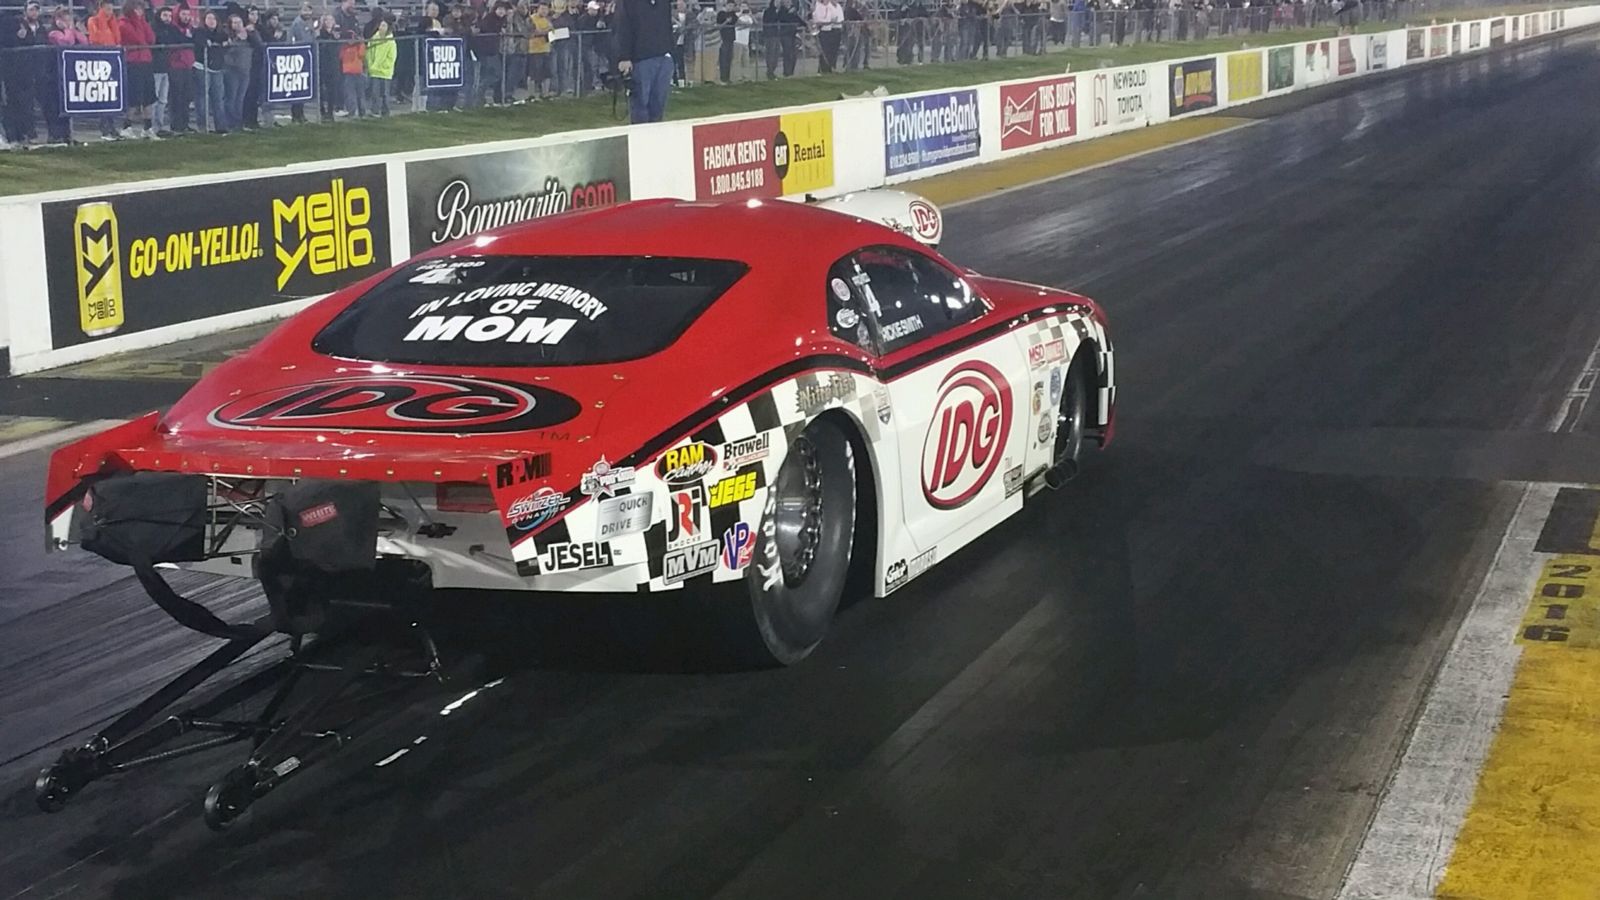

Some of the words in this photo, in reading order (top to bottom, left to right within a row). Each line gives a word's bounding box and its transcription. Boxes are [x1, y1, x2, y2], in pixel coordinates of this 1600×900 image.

[276, 54, 304, 73] BUD
[433, 46, 457, 62] BUD
[75, 60, 112, 80] BUD
[272, 72, 309, 93] LIGHT
[429, 62, 460, 80] LIGHT
[1113, 69, 1147, 89] NEWBOLD
[69, 81, 118, 102] LIGHT
[1039, 85, 1055, 111] THIS
[1117, 95, 1143, 115] TOYOTA
[886, 94, 978, 145] ProvidenceBank
[1040, 112, 1054, 137] FOR
[703, 142, 737, 170] FABICK
[737, 139, 767, 164] RENTS
[775, 145, 787, 166] CAT
[794, 140, 825, 162] Rental
[273, 178, 371, 243] Mello
[432, 177, 616, 243] Bommaritocom
[912, 207, 938, 233] IDG
[129, 222, 260, 279] GO-ON-YELLO!
[408, 268, 456, 285] 4
[408, 296, 450, 319] IN
[447, 282, 537, 307] LOVING
[533, 282, 608, 321] MEMORY
[489, 299, 542, 315] OF
[403, 315, 577, 344] MOM
[229, 384, 520, 424] IDG
[724, 432, 769, 460] Browell
[929, 394, 1001, 493] IDG
[666, 443, 704, 472] RAM
[709, 472, 757, 508] JEGS
[302, 503, 336, 520] WHITE
[619, 497, 648, 512] QUICK
[602, 519, 631, 535] DRIVE
[544, 541, 608, 571] JESEL
[725, 522, 750, 570] VP
[667, 545, 717, 578] MVM
[1523, 564, 1592, 642] 2016
